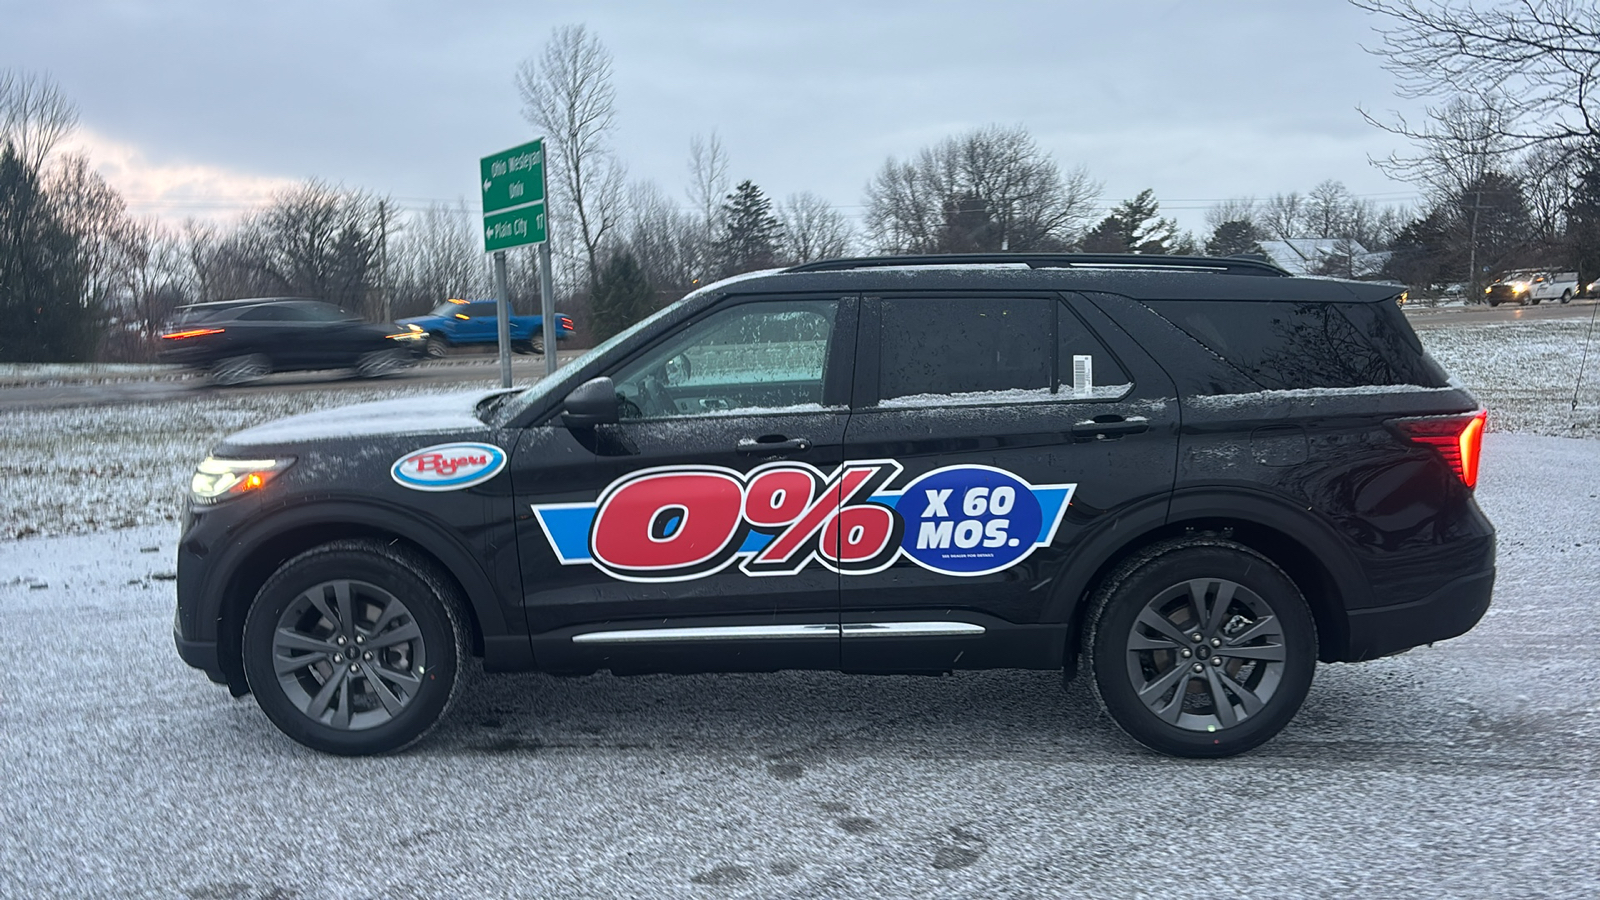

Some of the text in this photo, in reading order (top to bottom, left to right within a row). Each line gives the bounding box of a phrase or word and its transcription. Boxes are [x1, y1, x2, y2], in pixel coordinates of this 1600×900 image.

[491, 151, 541, 178] Ohio Wesleyan
[509, 180, 524, 199] Univ
[495, 213, 543, 240] Plain City 17
[407, 453, 487, 476] Byers
[920, 486, 1016, 518] X 60
[590, 462, 898, 578] 0%
[916, 519, 1020, 549] MOS.
